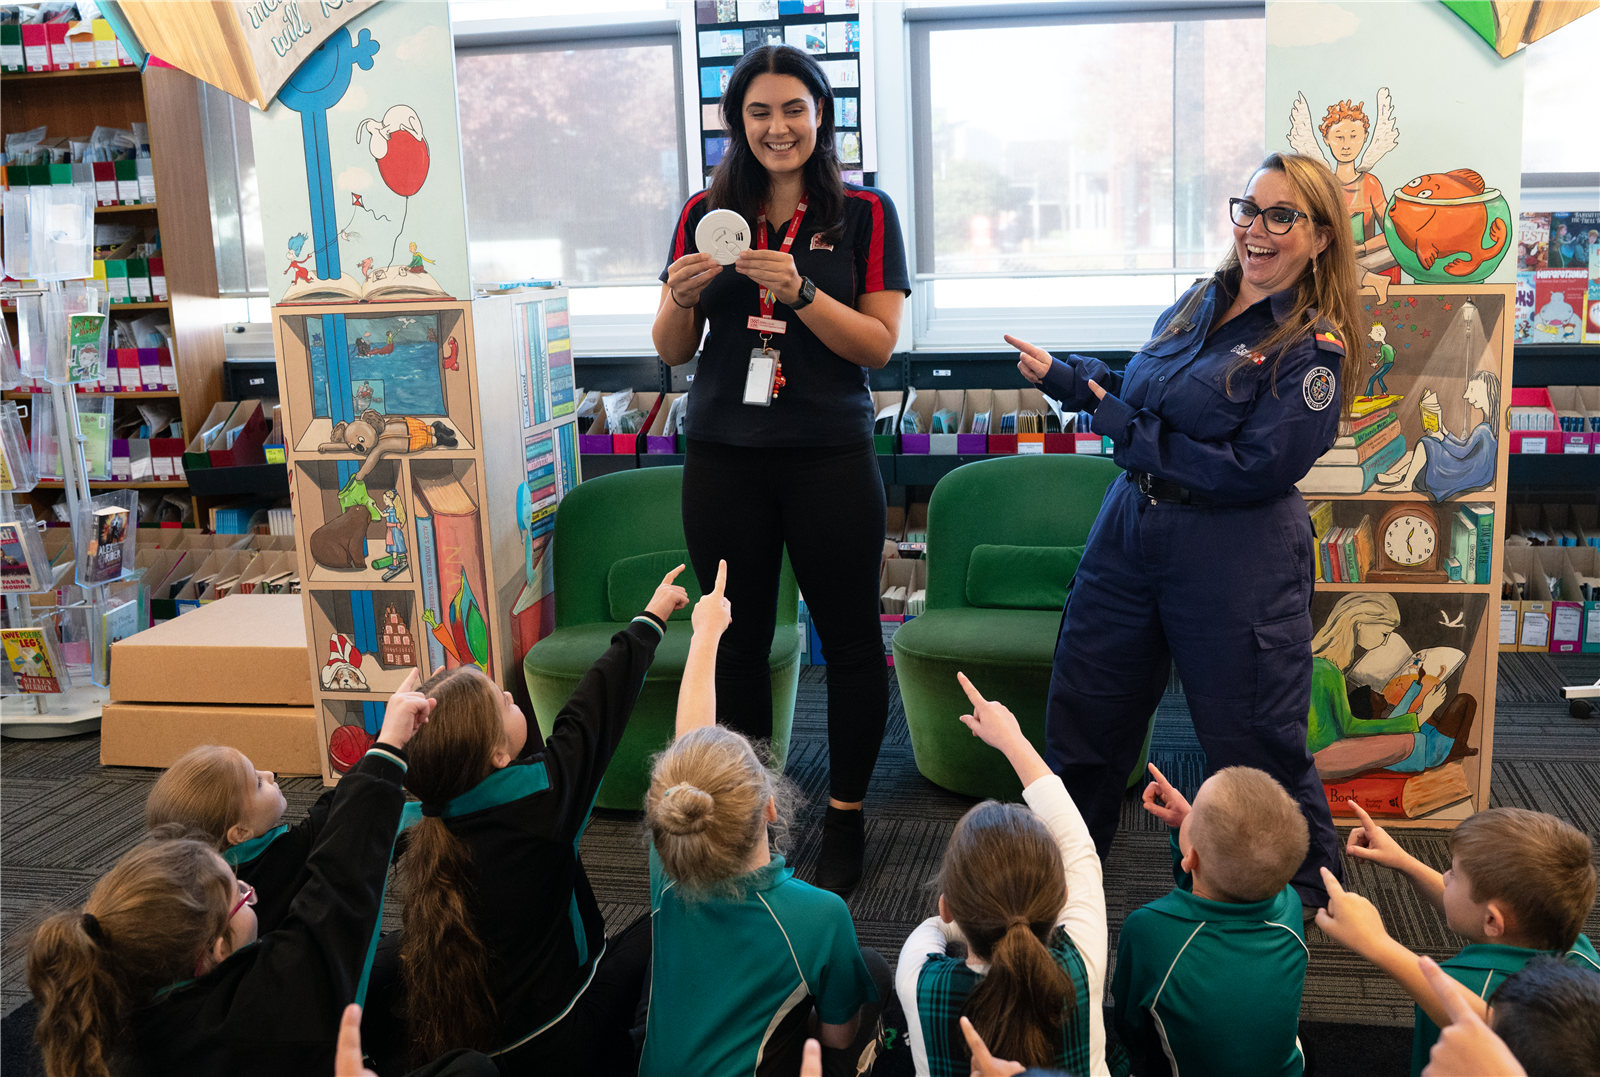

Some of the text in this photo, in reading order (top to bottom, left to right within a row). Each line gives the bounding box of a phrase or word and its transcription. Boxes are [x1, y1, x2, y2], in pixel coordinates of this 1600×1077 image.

[271, 1, 311, 57] will
[1537, 270, 1588, 279] HIPPOPOTAMUS
[520, 374, 528, 407] Cloud
[0, 529, 14, 540] di
[1479, 523, 1491, 564] TOM SAWYER
[98, 544, 113, 556] ALEX
[2, 632, 20, 640] LOVE
[19, 639, 36, 648] LEG
[1330, 788, 1358, 803] Book
